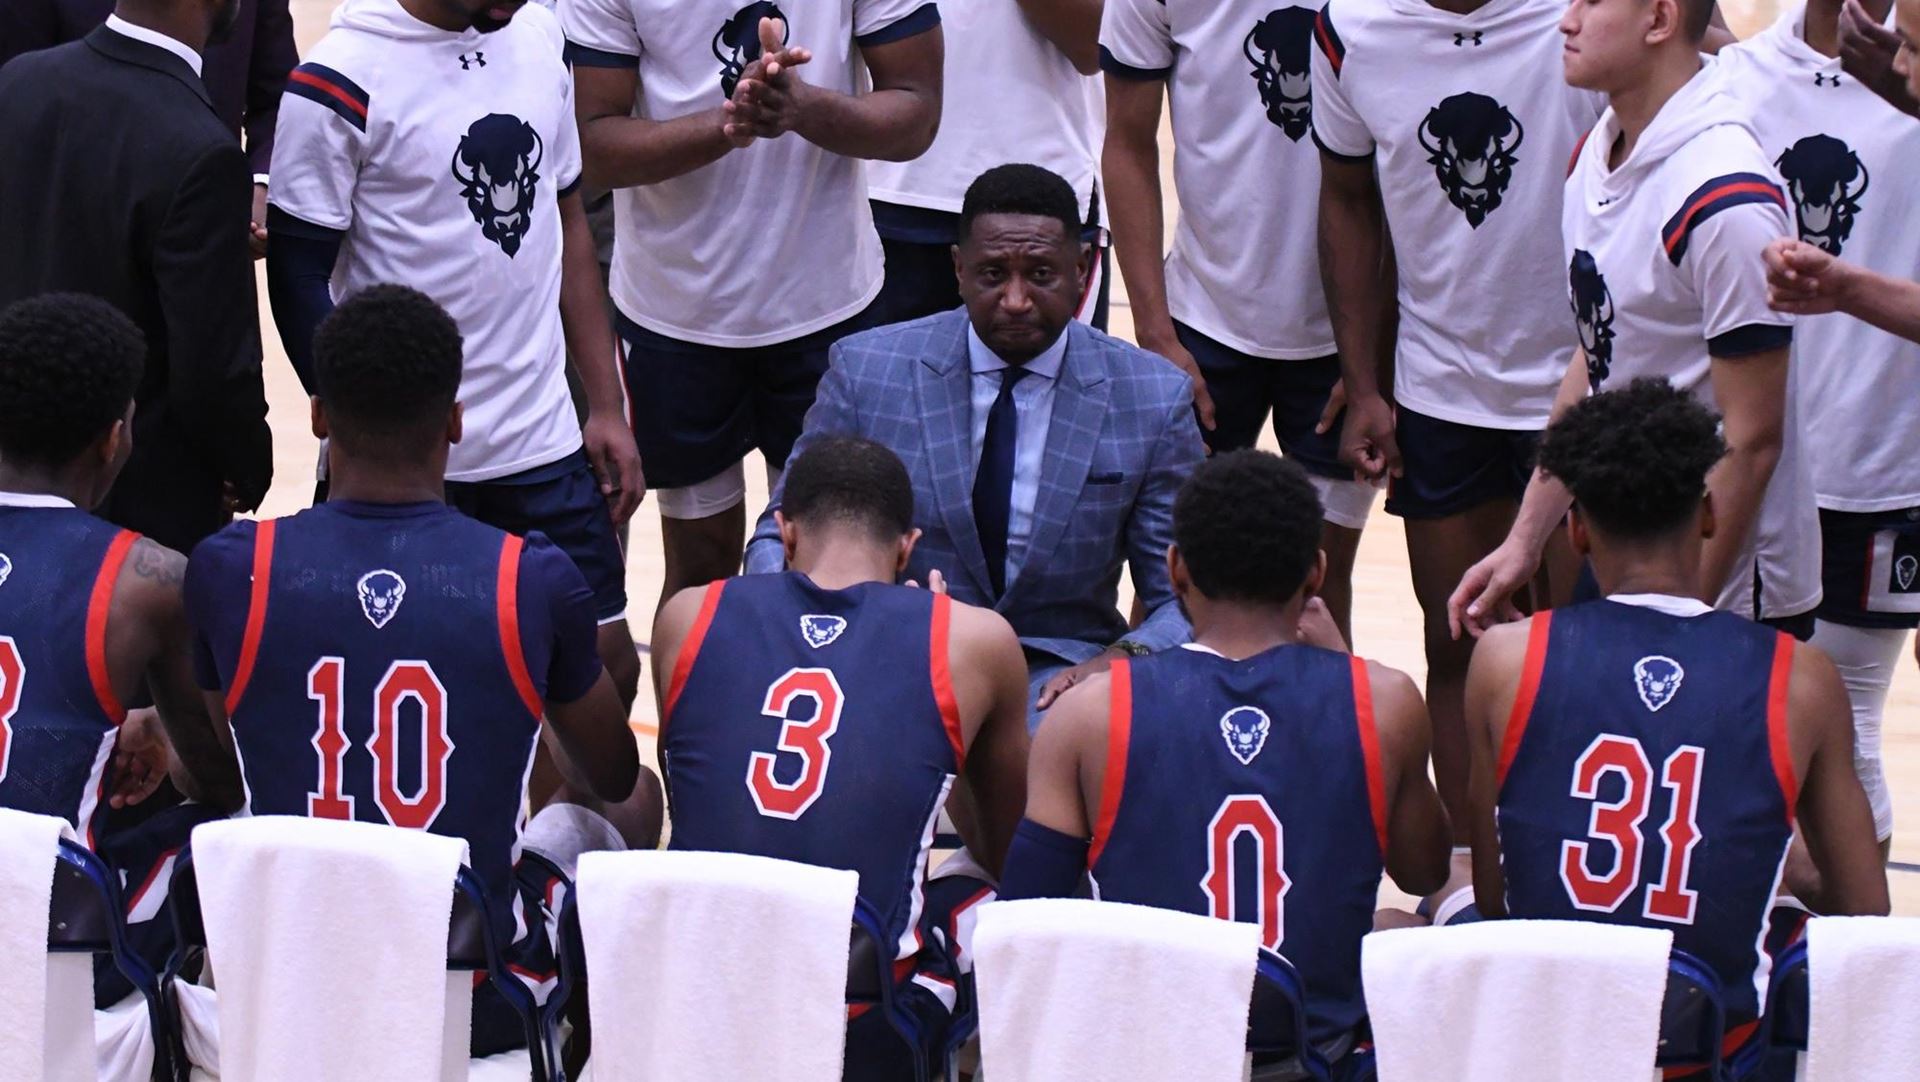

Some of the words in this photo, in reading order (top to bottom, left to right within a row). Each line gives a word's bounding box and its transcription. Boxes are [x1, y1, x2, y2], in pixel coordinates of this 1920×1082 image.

[307, 656, 456, 831] 10
[745, 667, 845, 821] 3
[1199, 794, 1293, 952] 0
[1559, 733, 1705, 925] 31
